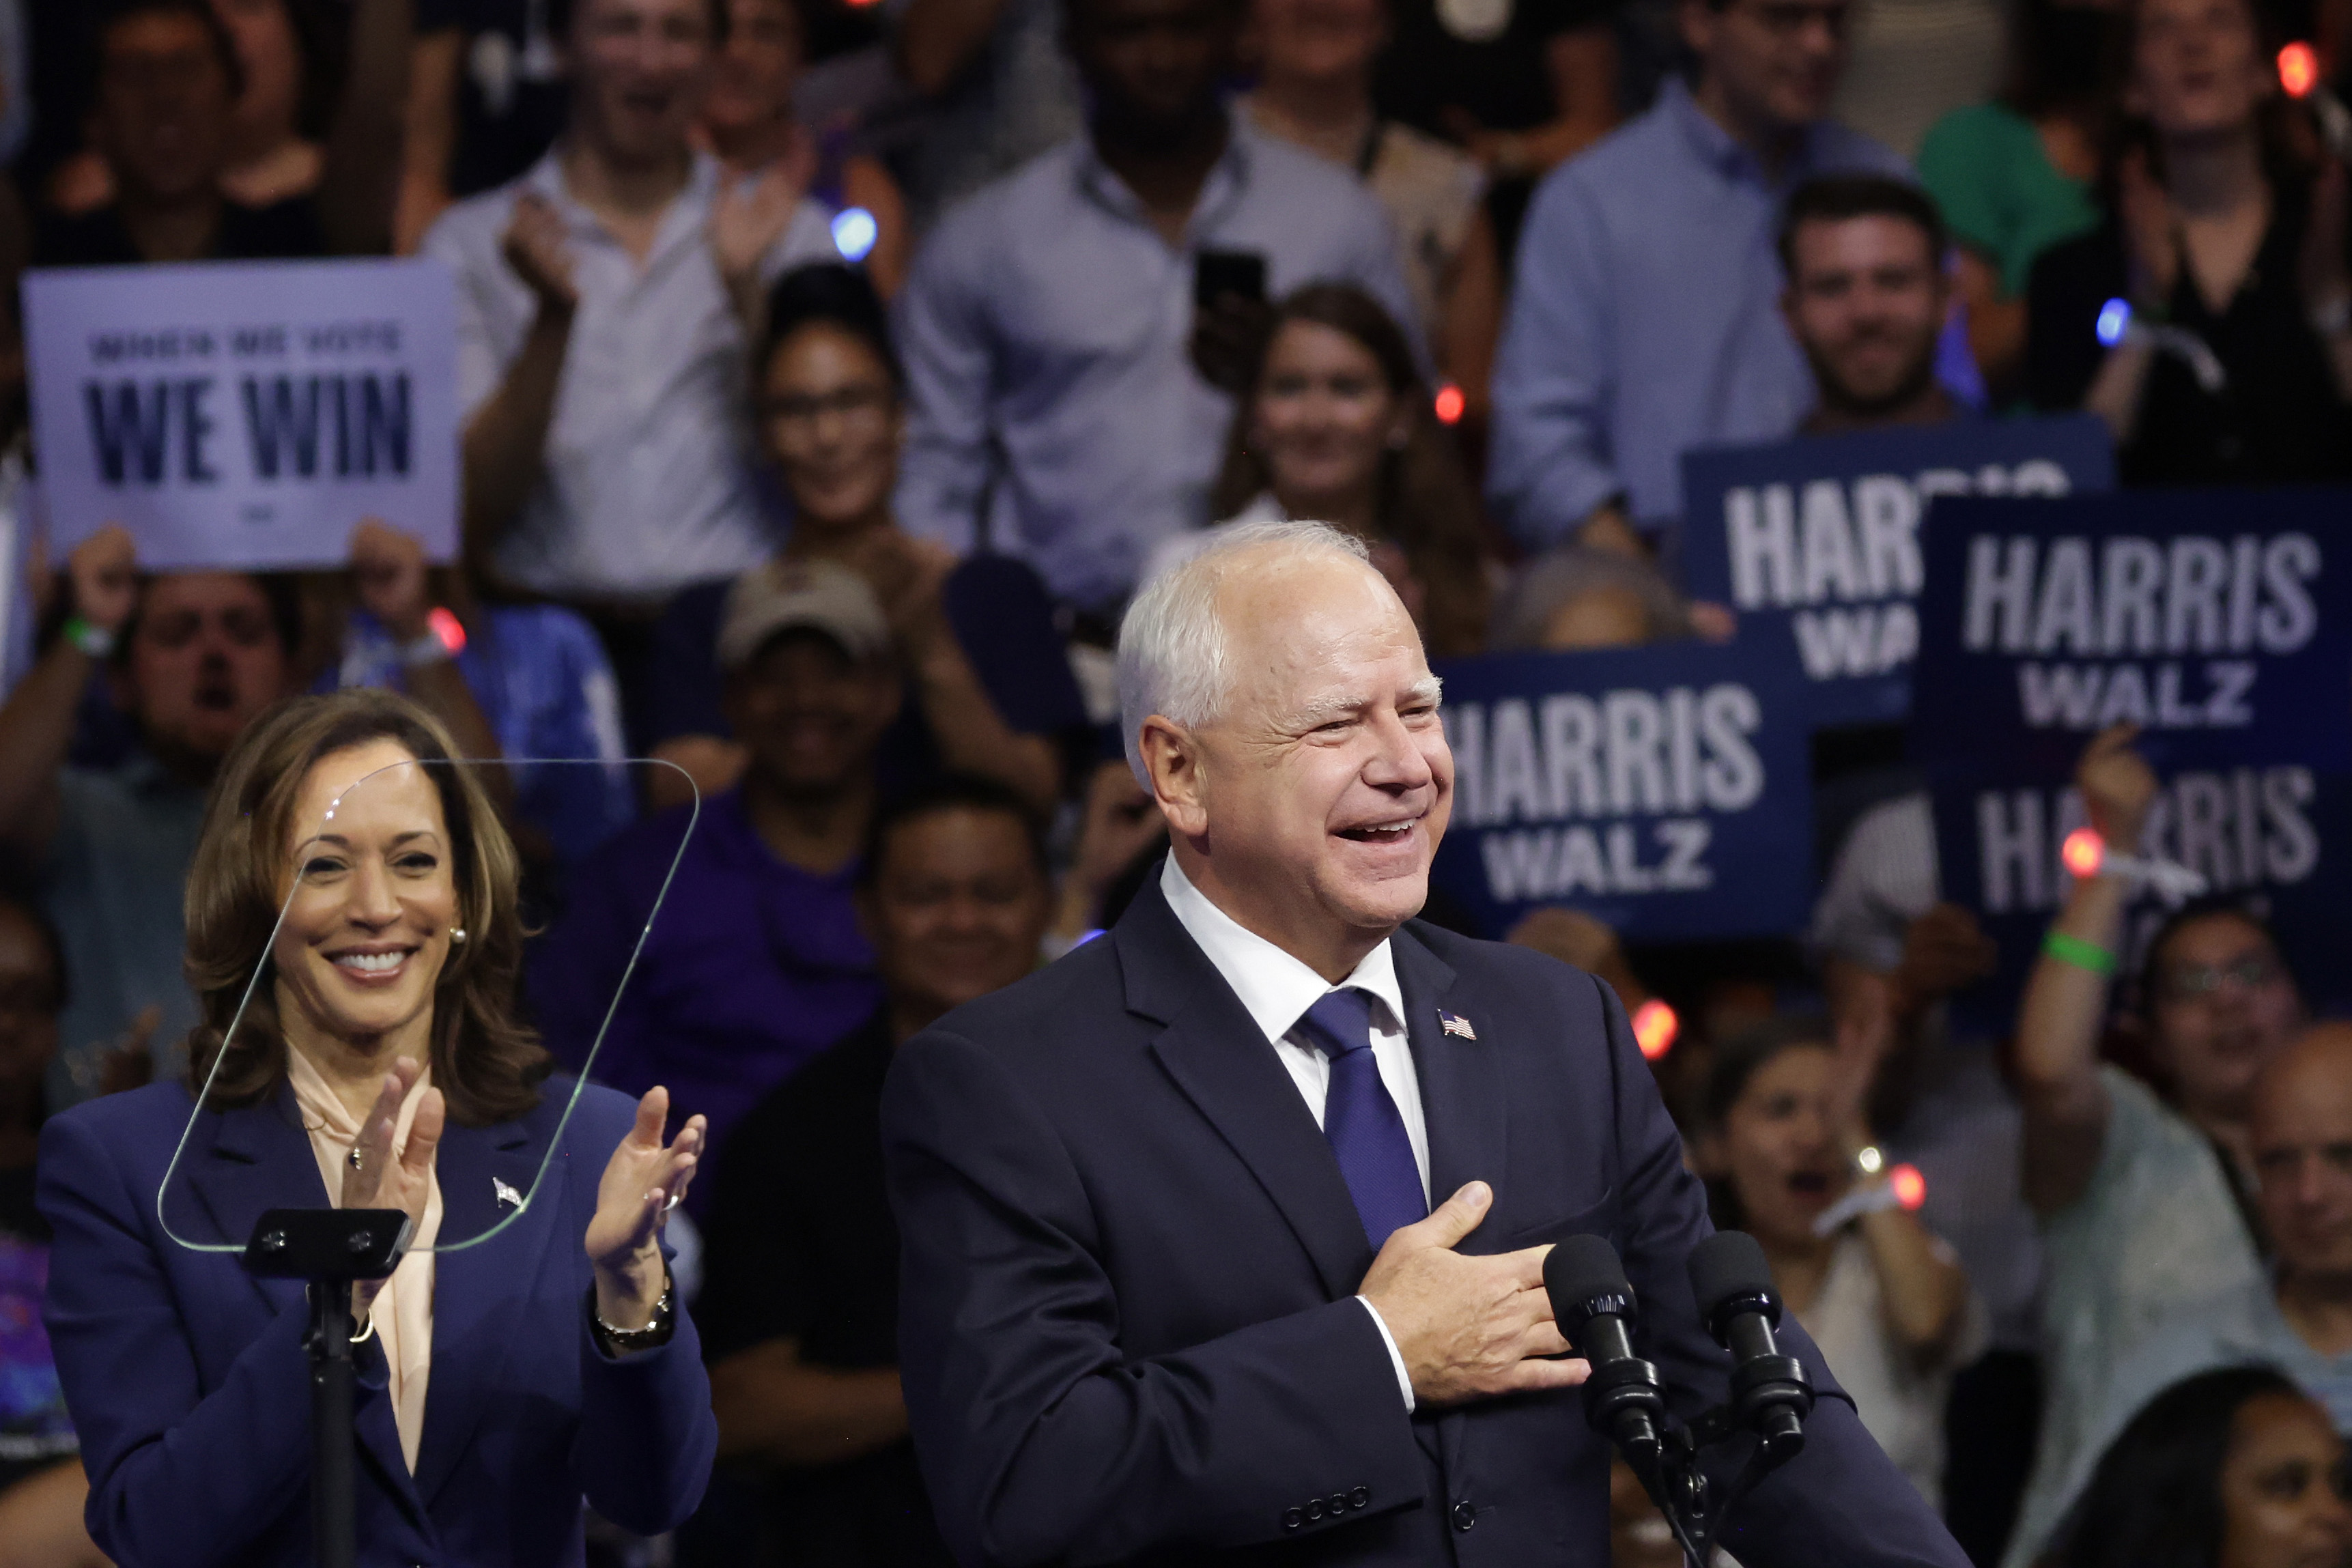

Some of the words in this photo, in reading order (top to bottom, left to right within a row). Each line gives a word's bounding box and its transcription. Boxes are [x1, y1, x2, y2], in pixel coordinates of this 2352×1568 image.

[232, 324, 287, 355] WE
[83, 377, 216, 486] WE
[239, 369, 412, 481] WIN
[1724, 459, 2070, 609] HAR
[1962, 532, 2321, 655] HARRIS
[1792, 603, 1920, 681] WA
[2017, 662, 2257, 729] WALZ
[1480, 819, 1714, 902] WALZ
